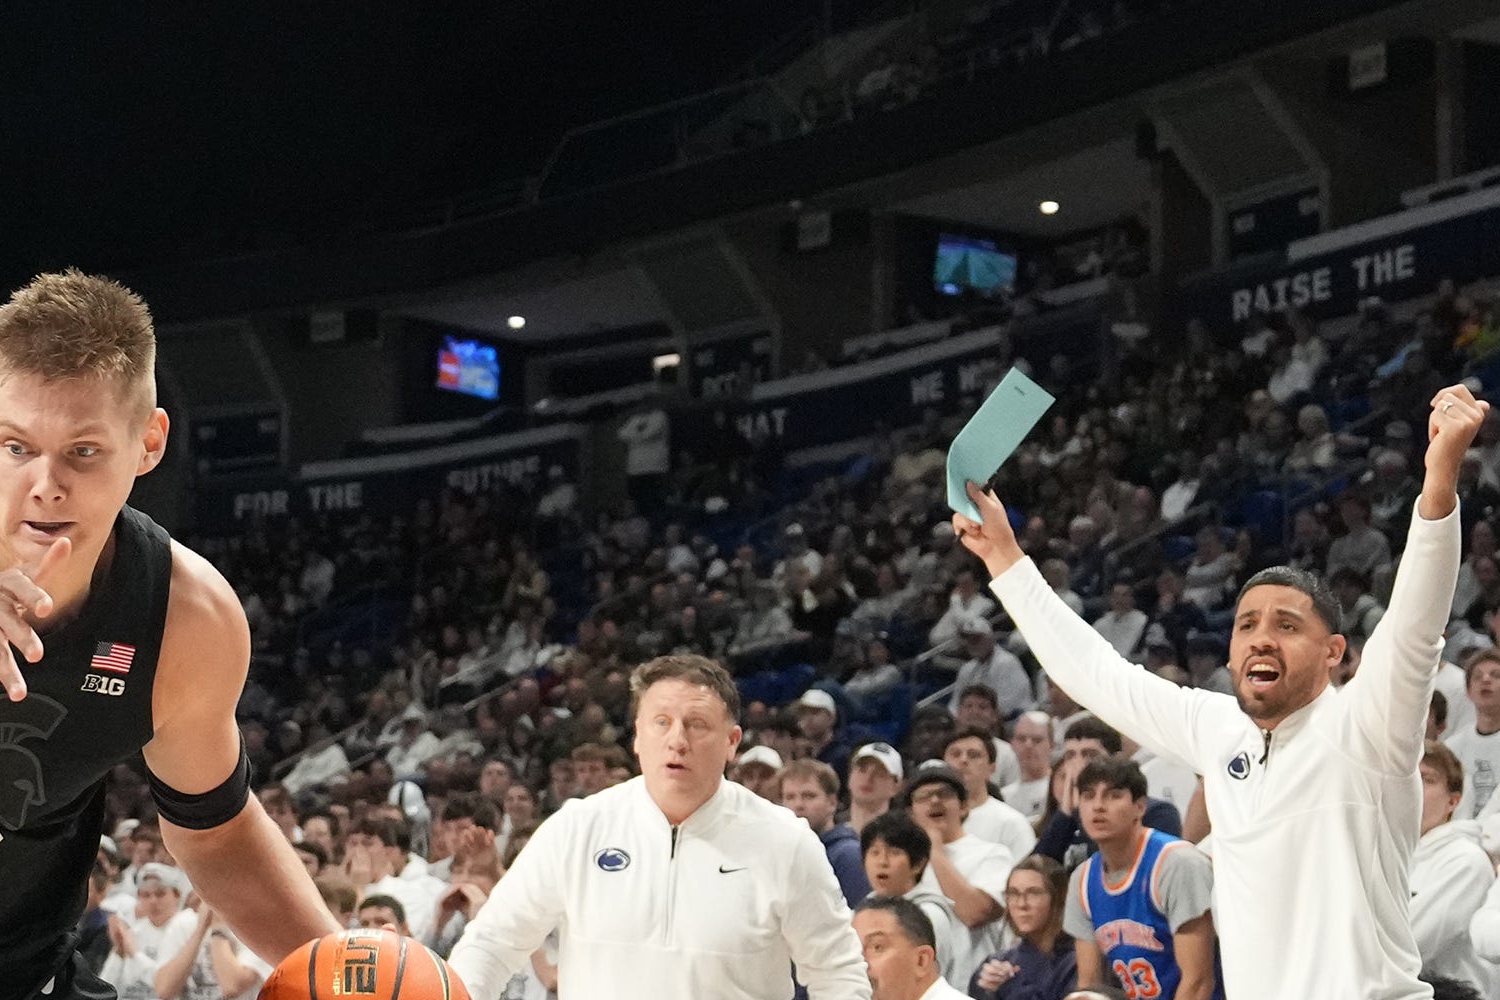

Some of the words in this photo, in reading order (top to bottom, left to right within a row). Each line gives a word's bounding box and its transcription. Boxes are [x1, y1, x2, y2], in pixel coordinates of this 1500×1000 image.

[1231, 266, 1332, 322] RAISE
[1351, 243, 1415, 290] THE
[308, 481, 364, 511] THE
